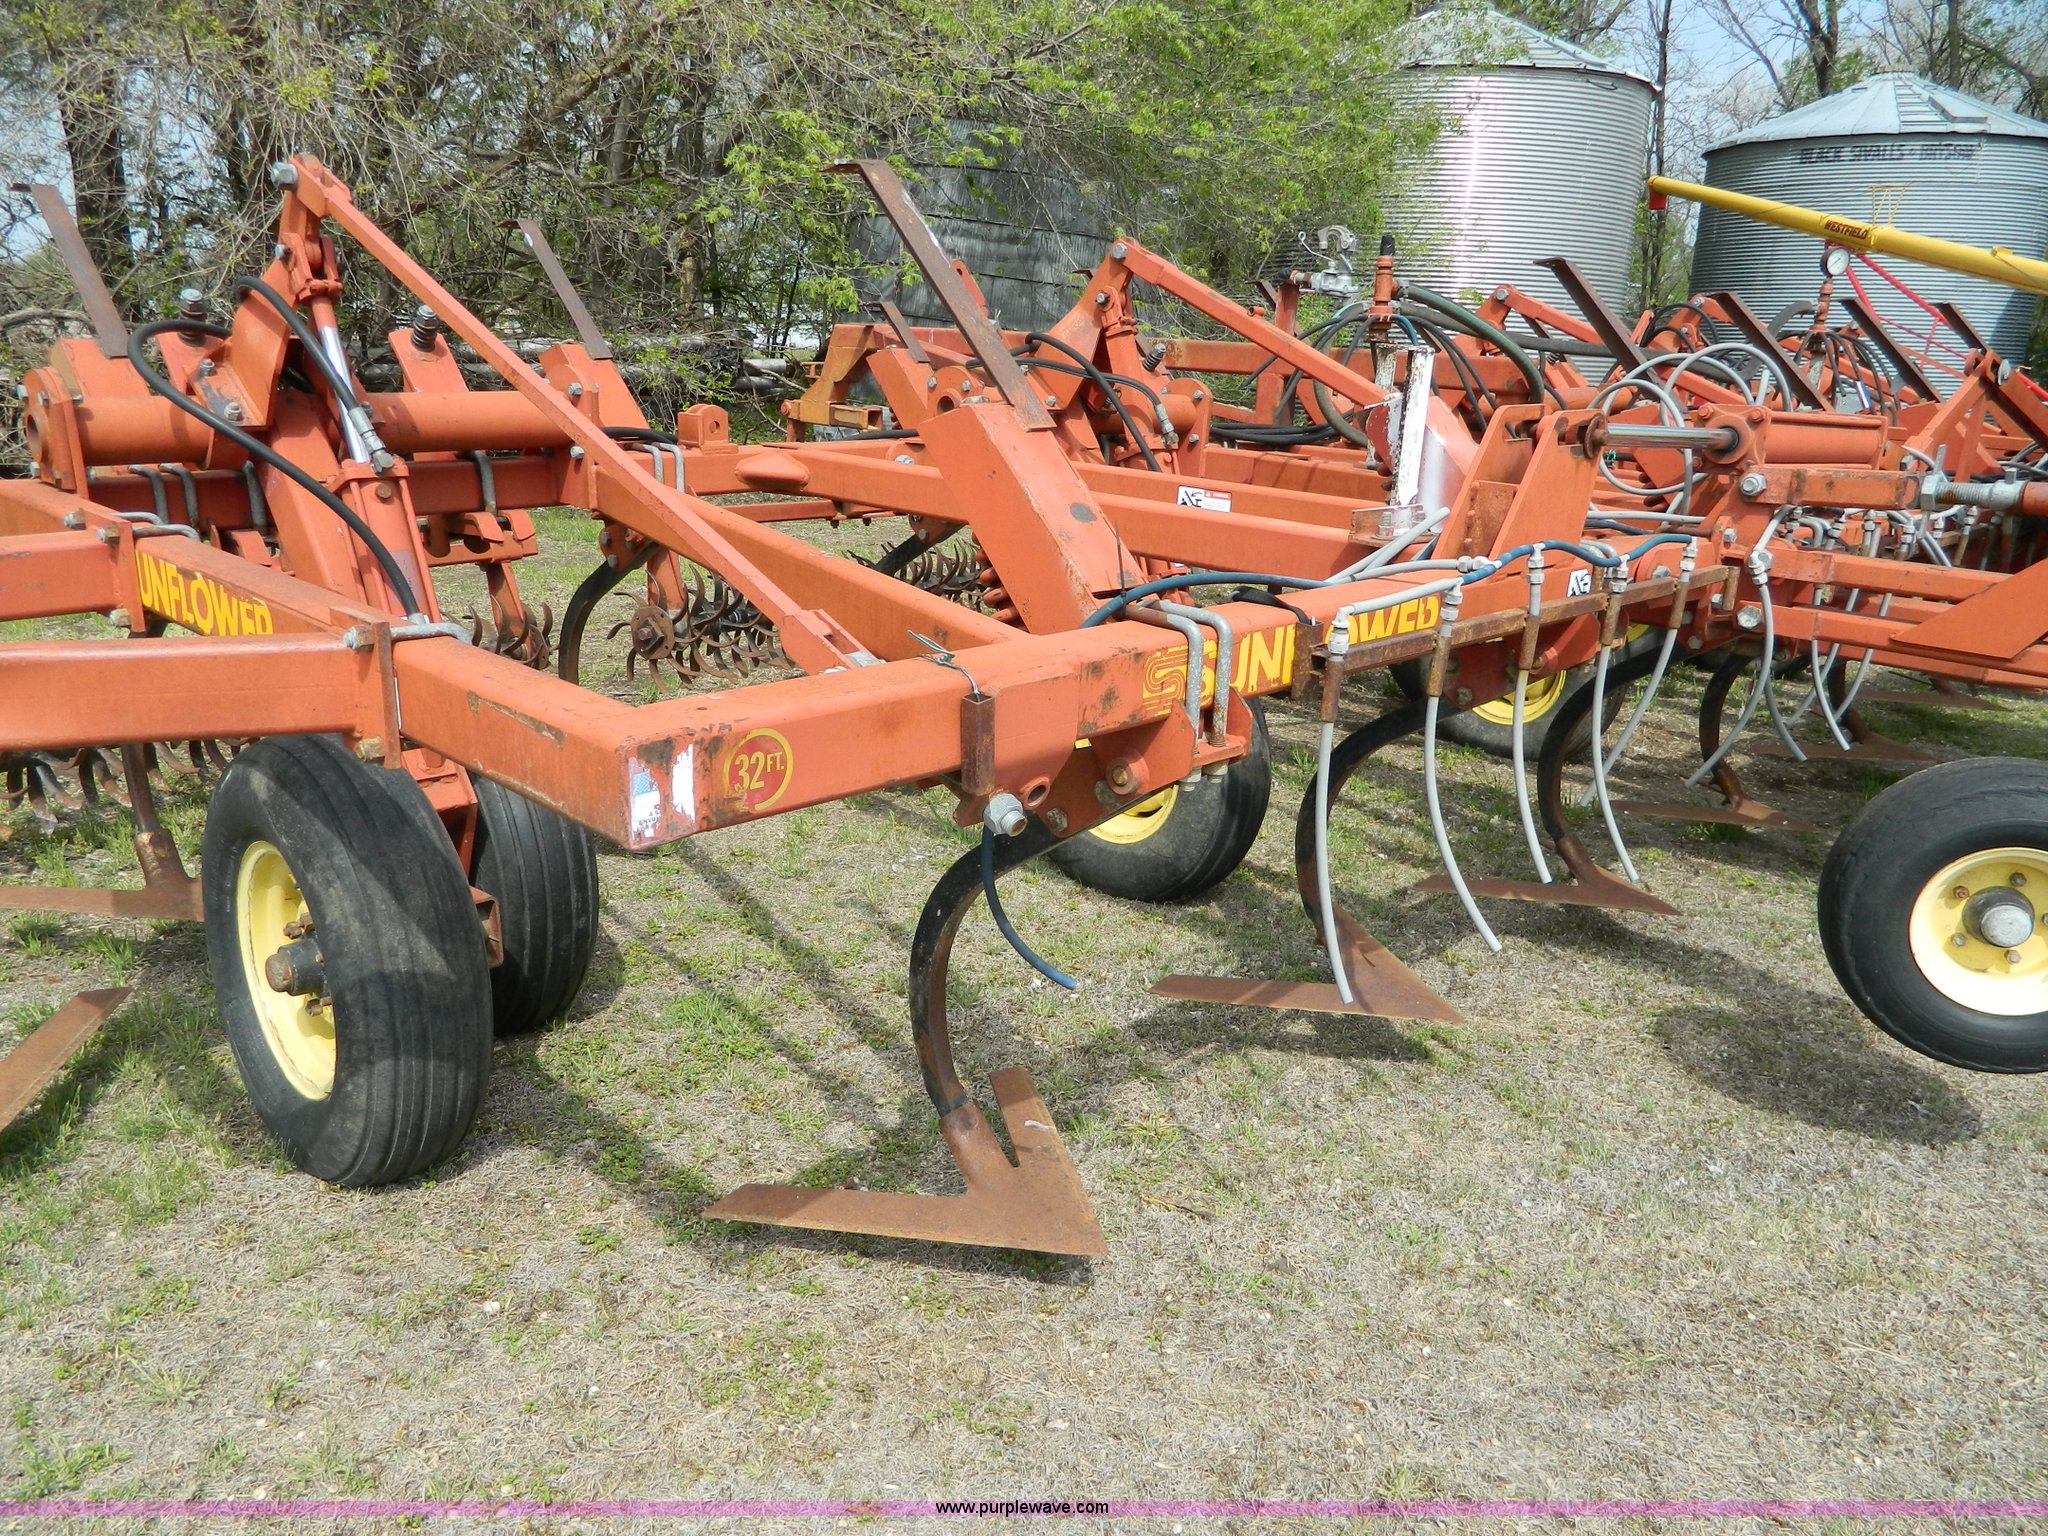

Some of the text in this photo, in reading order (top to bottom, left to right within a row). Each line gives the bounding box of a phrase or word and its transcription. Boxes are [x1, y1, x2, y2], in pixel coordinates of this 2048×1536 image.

[1800, 147, 1845, 164] BLACK
[1825, 220, 1869, 239] WESTFIELD
[135, 550, 273, 636] UNFLOWER
